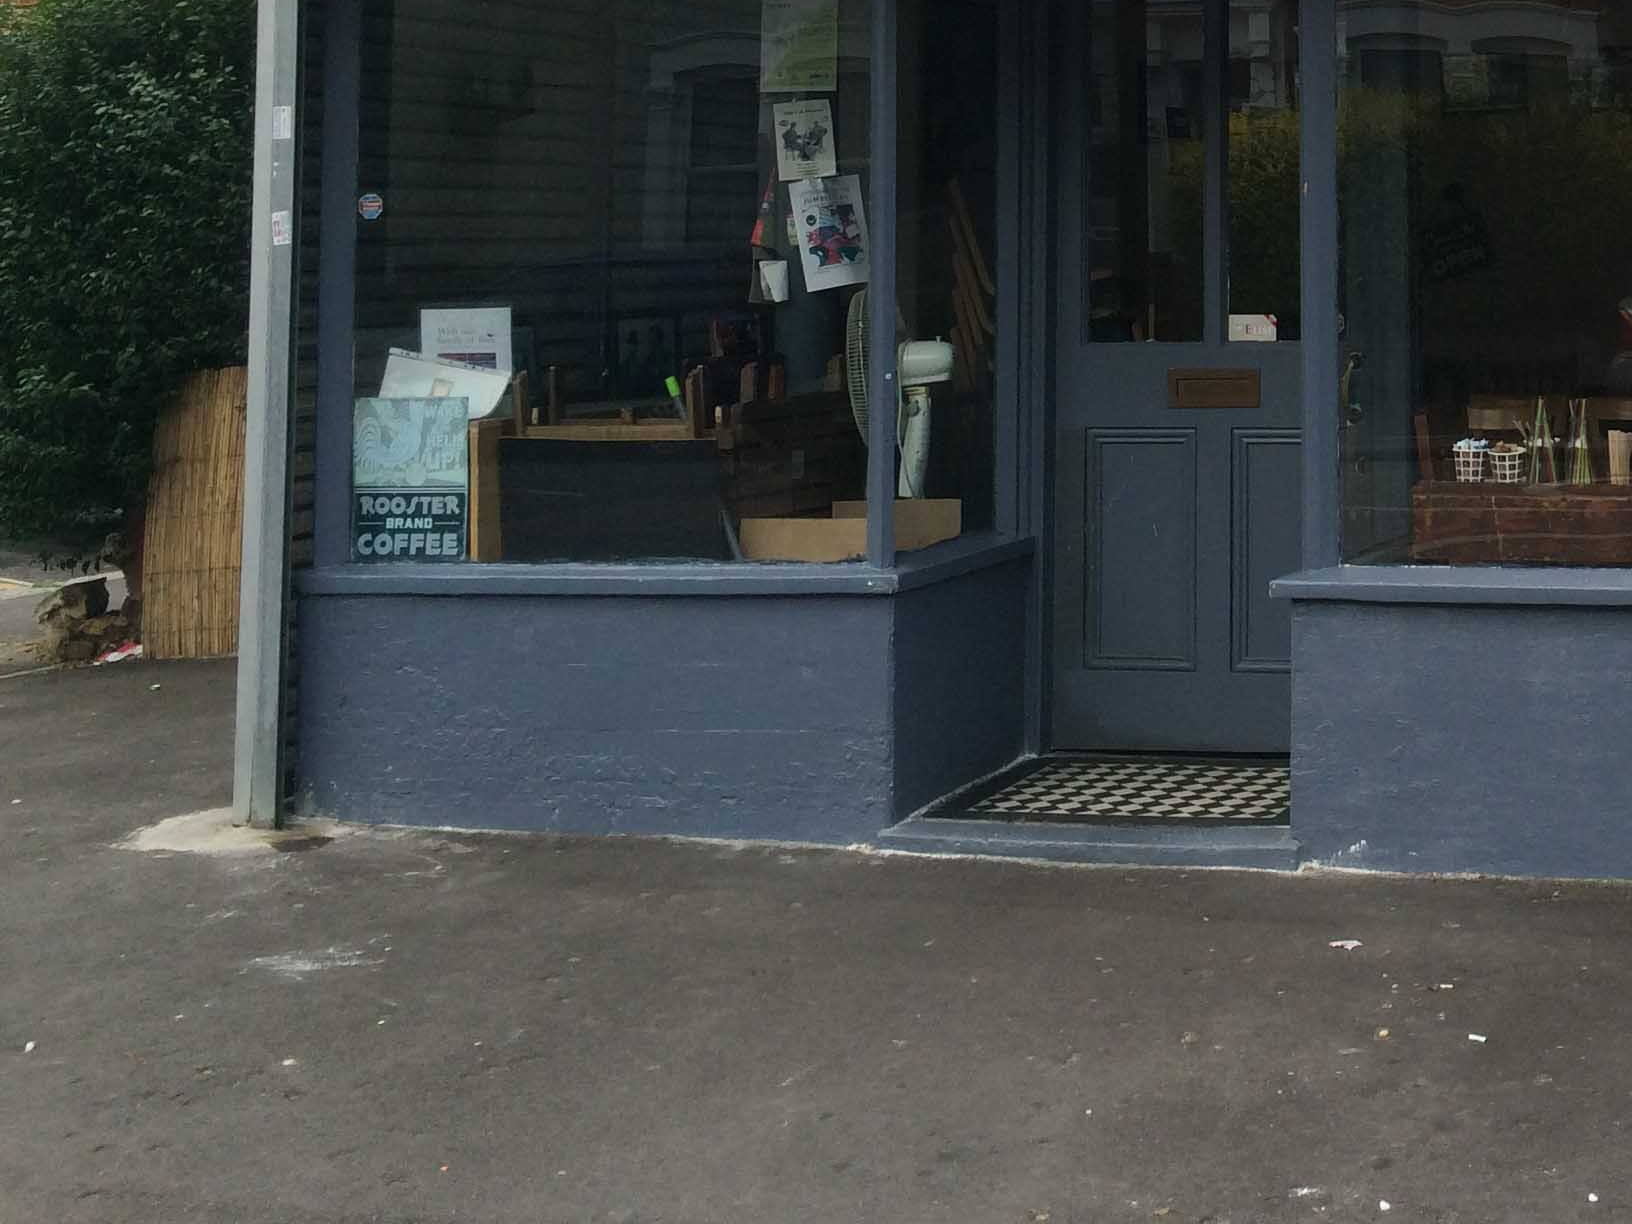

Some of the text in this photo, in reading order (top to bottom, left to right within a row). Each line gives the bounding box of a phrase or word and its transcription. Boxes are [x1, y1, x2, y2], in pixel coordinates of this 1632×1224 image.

[359, 495, 461, 515] ROOSTER
[385, 517, 433, 529] BRAND
[357, 531, 460, 556] COFFEE
